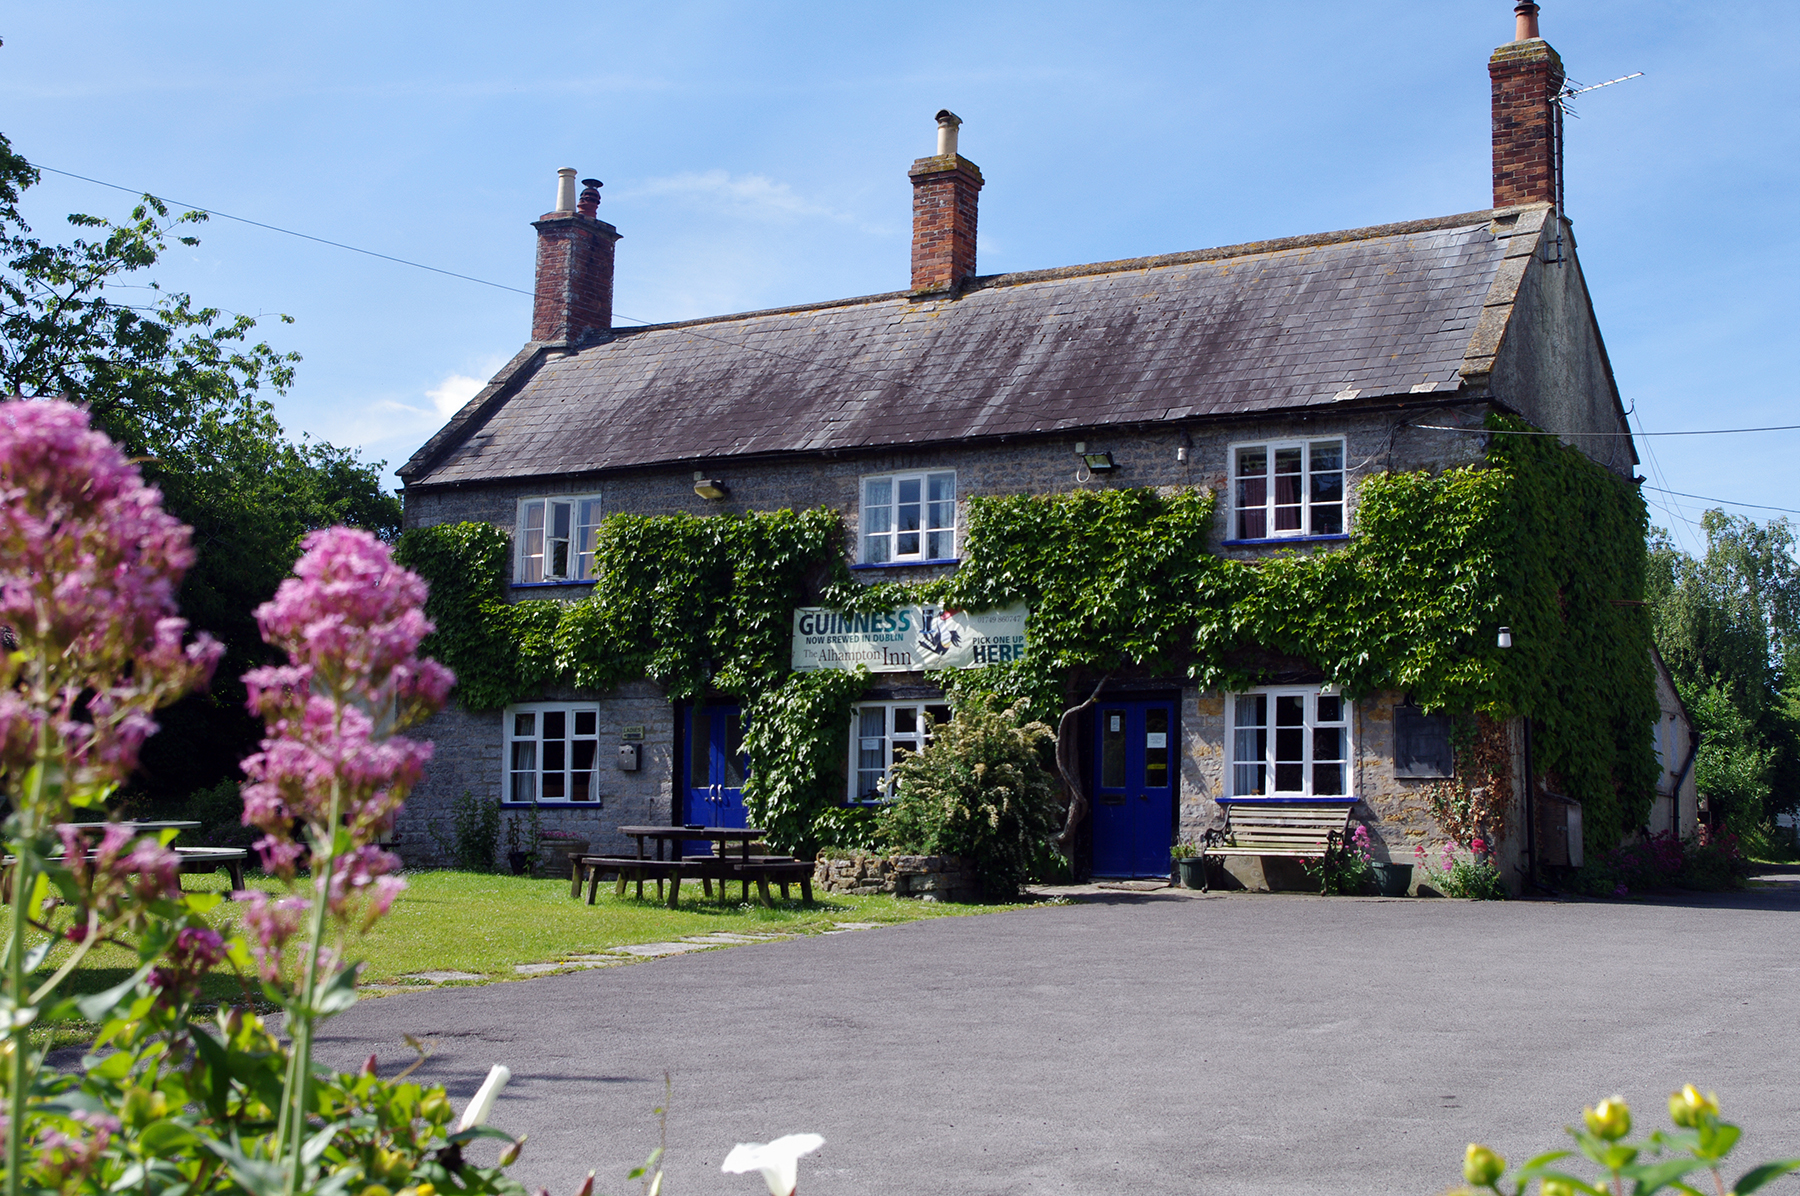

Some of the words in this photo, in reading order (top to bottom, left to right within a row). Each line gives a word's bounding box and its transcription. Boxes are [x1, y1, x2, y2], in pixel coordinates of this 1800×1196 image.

[799, 610, 911, 635] GUINNESS
[805, 636, 825, 644] NOW
[827, 635, 859, 644] BREWED
[873, 634, 904, 642] DUBLIN
[972, 636, 991, 644] PICK
[993, 636, 1010, 644] ONE
[1012, 635, 1024, 643] UP
[803, 649, 818, 658] The
[818, 647, 881, 663] Alhampton
[882, 647, 912, 666] Inn
[973, 644, 1024, 663] HERE
